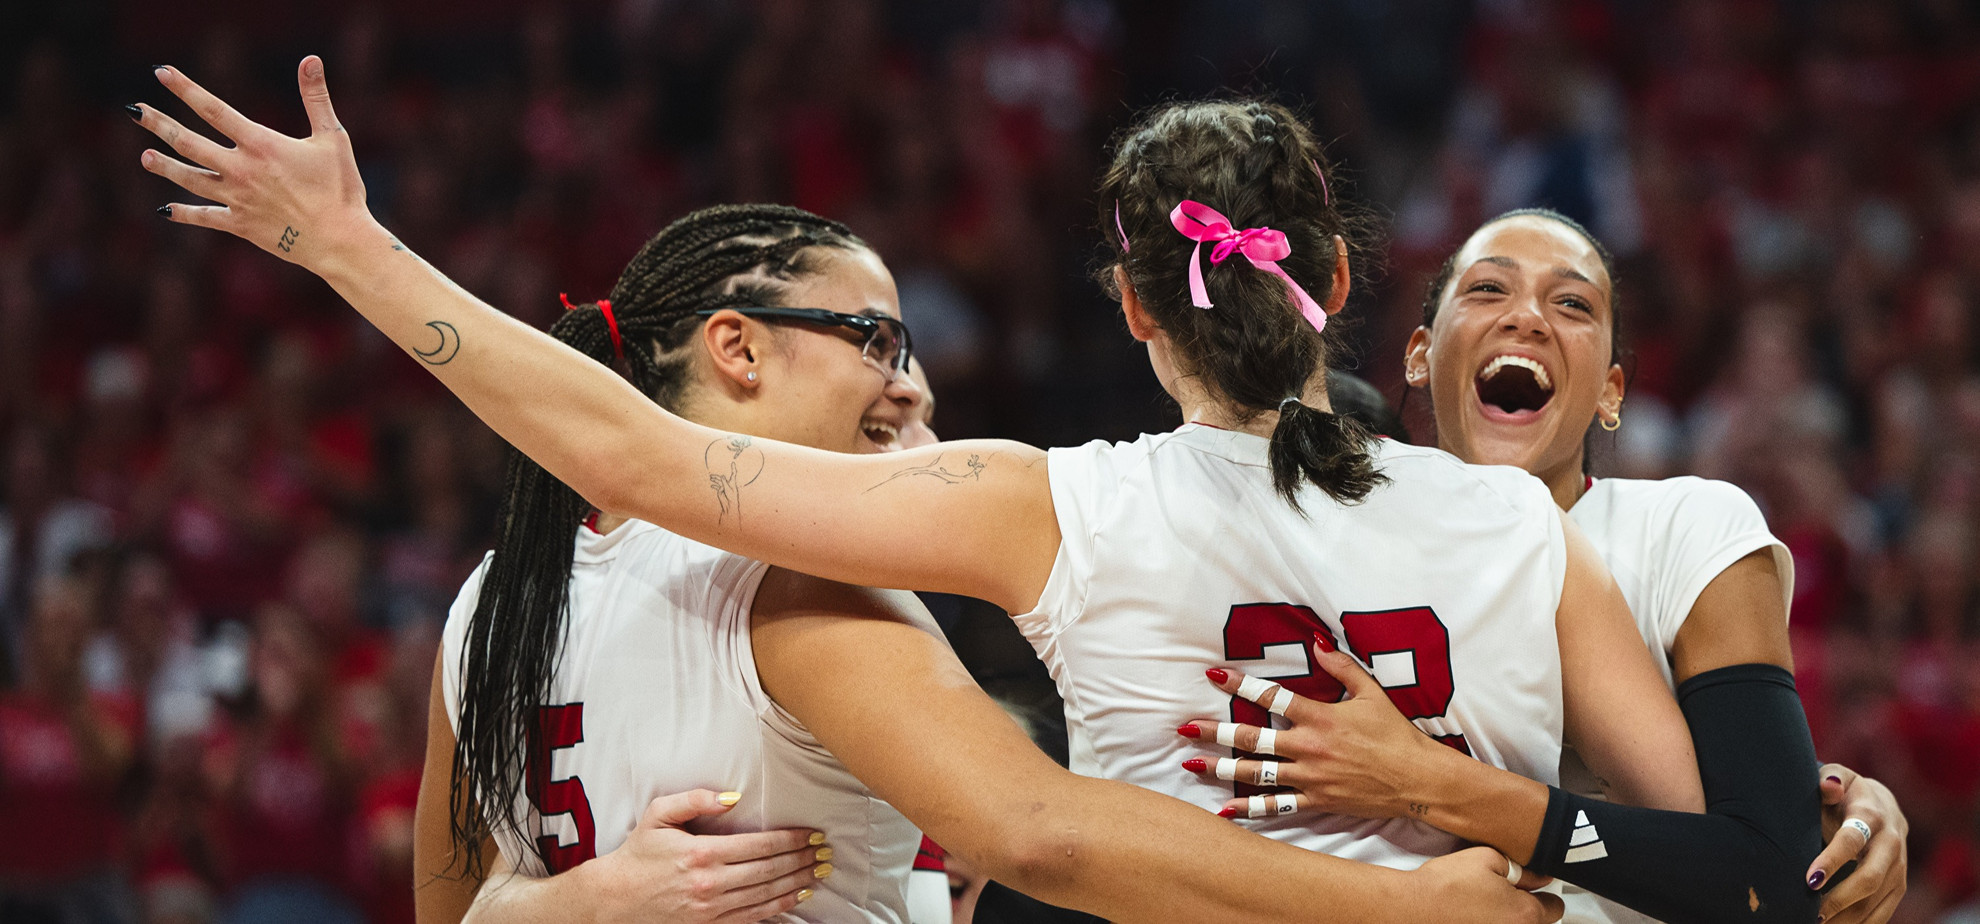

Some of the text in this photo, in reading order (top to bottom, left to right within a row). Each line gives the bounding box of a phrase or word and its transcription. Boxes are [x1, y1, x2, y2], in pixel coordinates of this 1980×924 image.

[278, 226, 299, 252] 222
[1222, 602, 1473, 799] 22
[524, 701, 598, 877] 5
